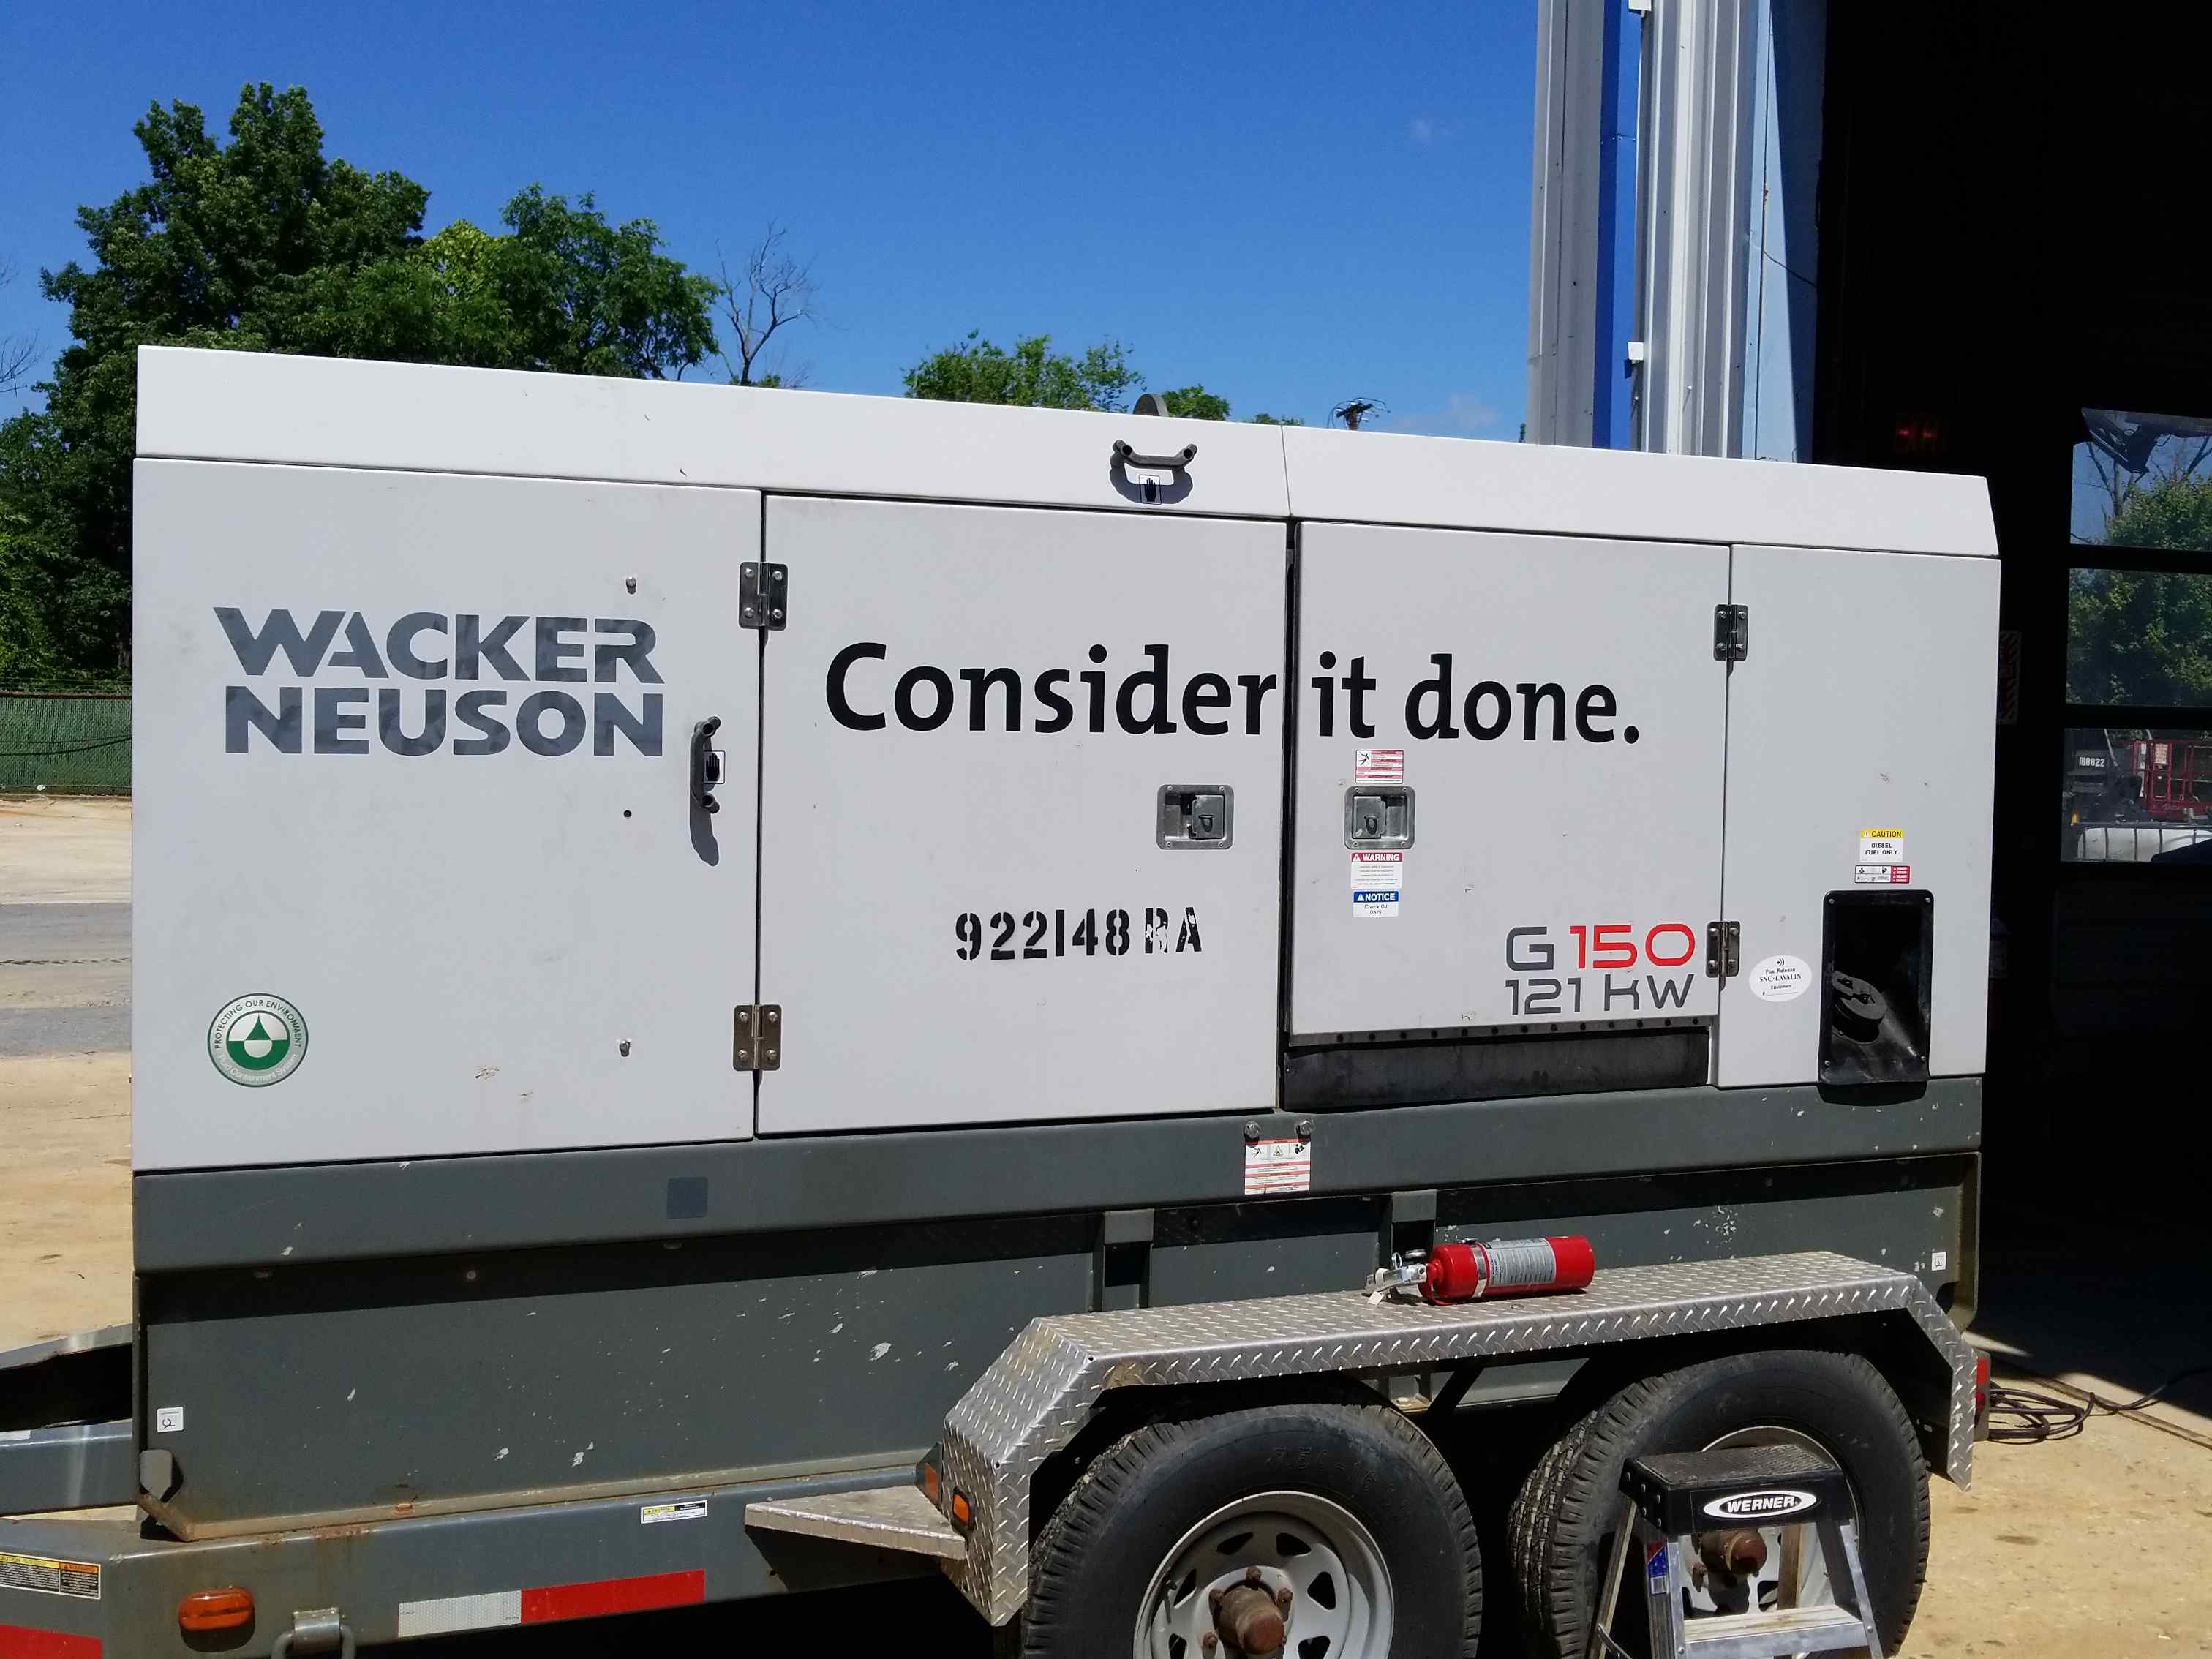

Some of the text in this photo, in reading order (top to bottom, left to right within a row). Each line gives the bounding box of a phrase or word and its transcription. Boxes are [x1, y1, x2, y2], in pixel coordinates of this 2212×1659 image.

[213, 606, 666, 684] WACKER
[826, 642, 1639, 745] Consider it done.
[225, 685, 663, 757] NEUSON
[1362, 854, 1400, 862] WARNING
[1365, 893, 1396, 901] NOTICE
[1506, 923, 1696, 971] G 150
[1505, 977, 1581, 1015] 121
[214, 999, 302, 1050] PROTECTING OUR ENVIRONMENT
[1727, 1496, 1795, 1513] WERNER
